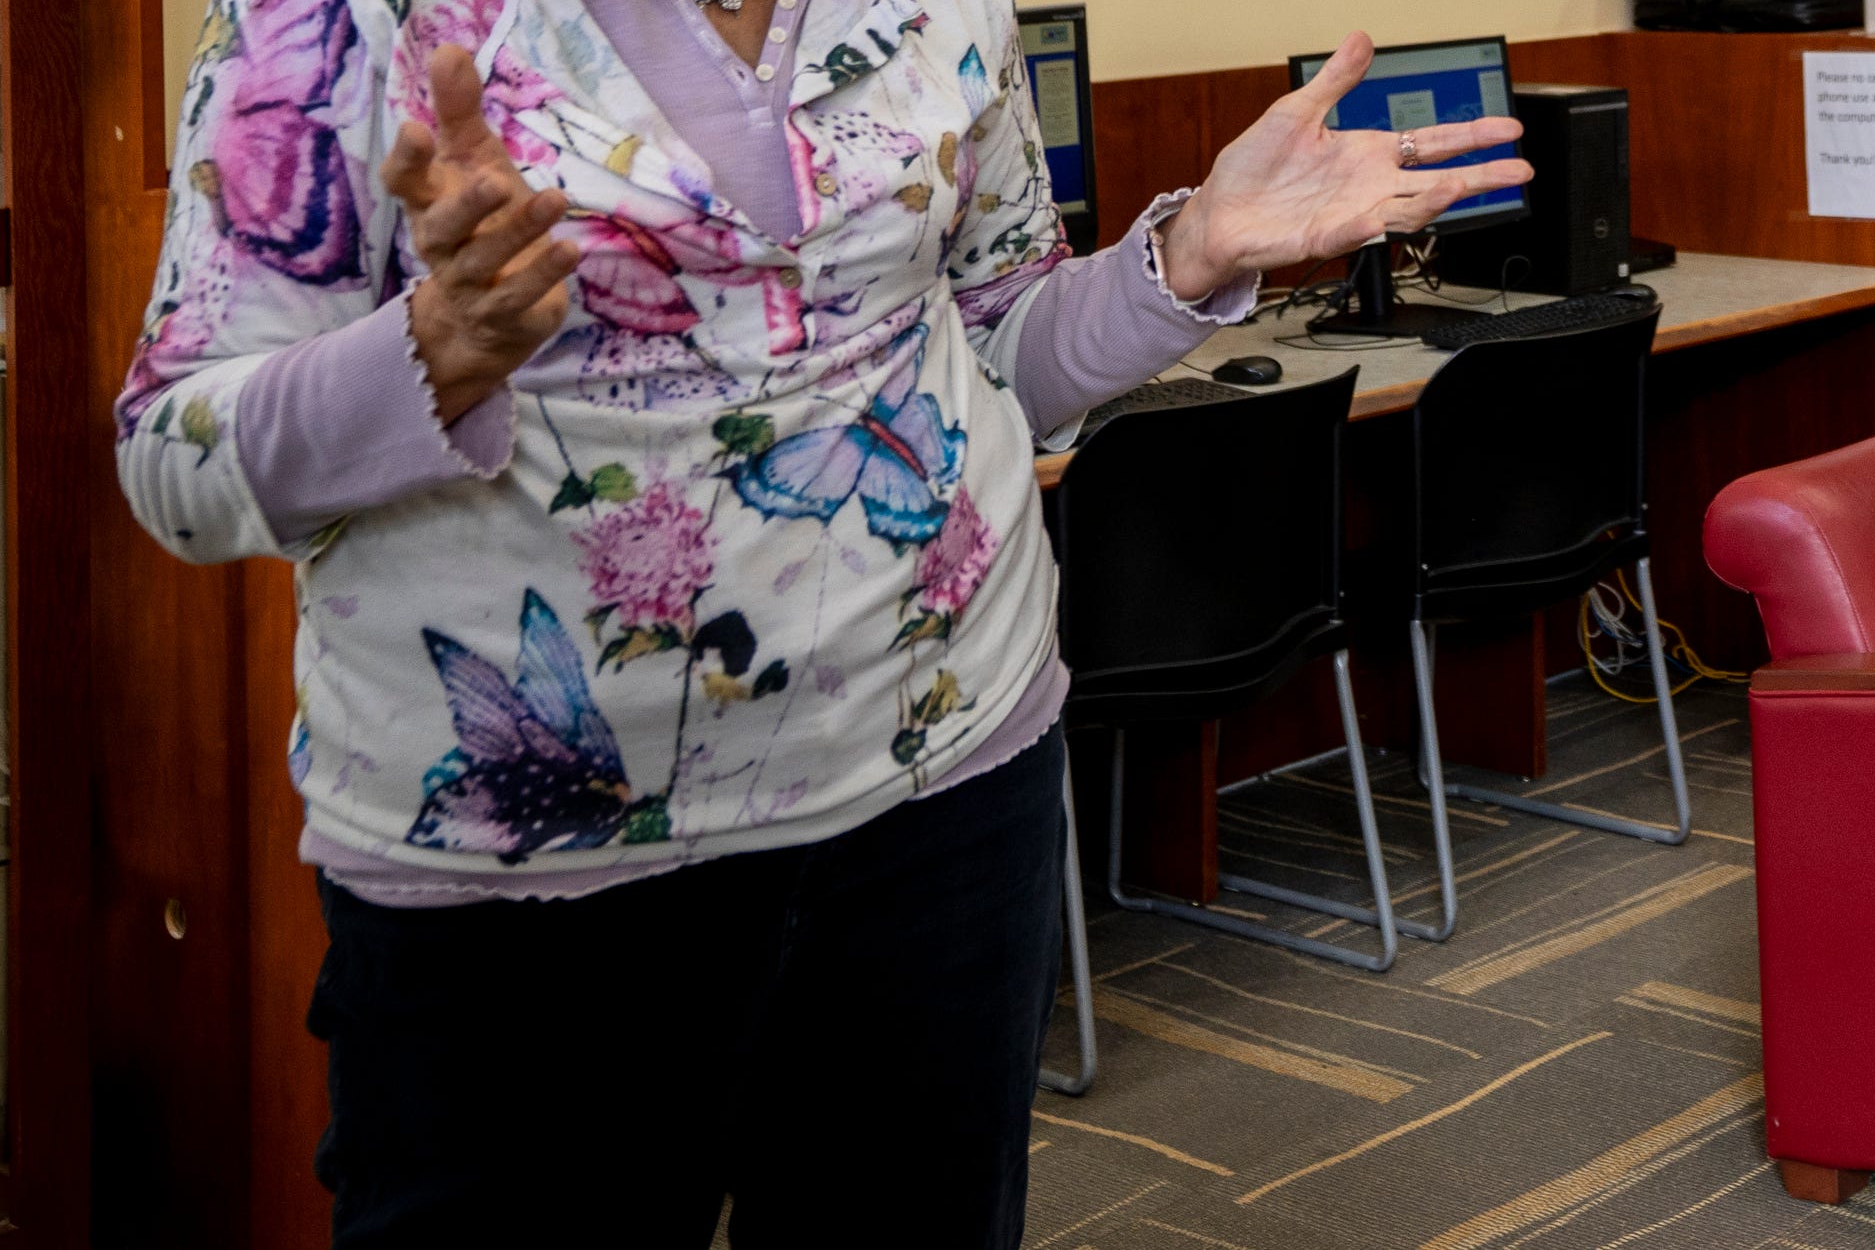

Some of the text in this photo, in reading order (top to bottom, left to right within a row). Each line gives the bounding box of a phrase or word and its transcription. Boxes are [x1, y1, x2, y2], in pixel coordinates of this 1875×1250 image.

[1817, 71, 1849, 84] Please
[1852, 73, 1865, 84] no
[1817, 91, 1849, 104] phone
[1852, 93, 1869, 104] use
[1818, 110, 1835, 123] the
[1820, 152, 1854, 165] Thank
